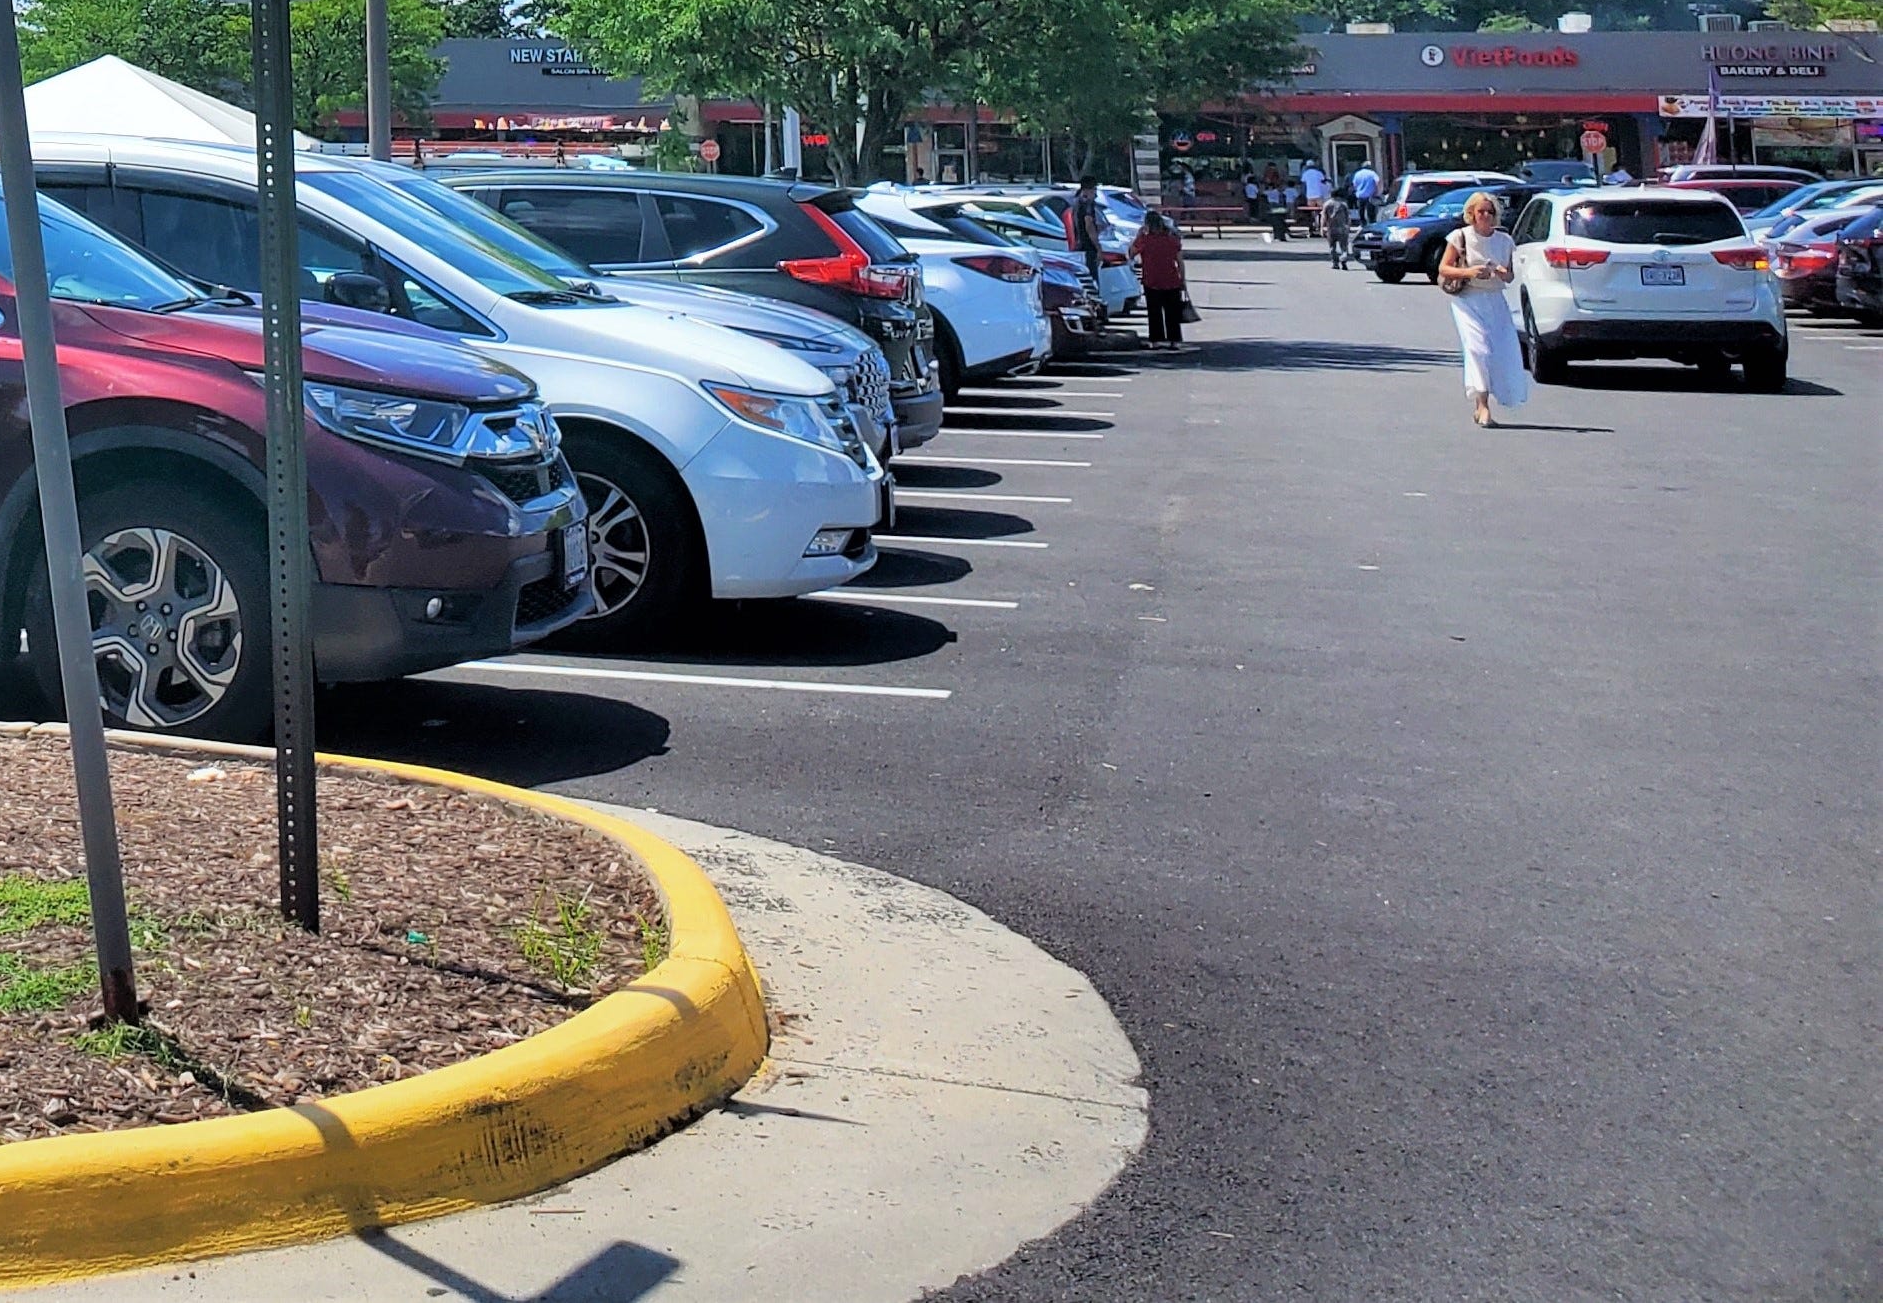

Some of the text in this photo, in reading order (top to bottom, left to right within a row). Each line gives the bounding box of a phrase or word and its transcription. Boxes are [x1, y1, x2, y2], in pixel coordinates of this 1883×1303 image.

[510, 48, 543, 63] NEW
[1720, 66, 1819, 75] BAKERY & DELI
[1582, 137, 1604, 147] STOP
